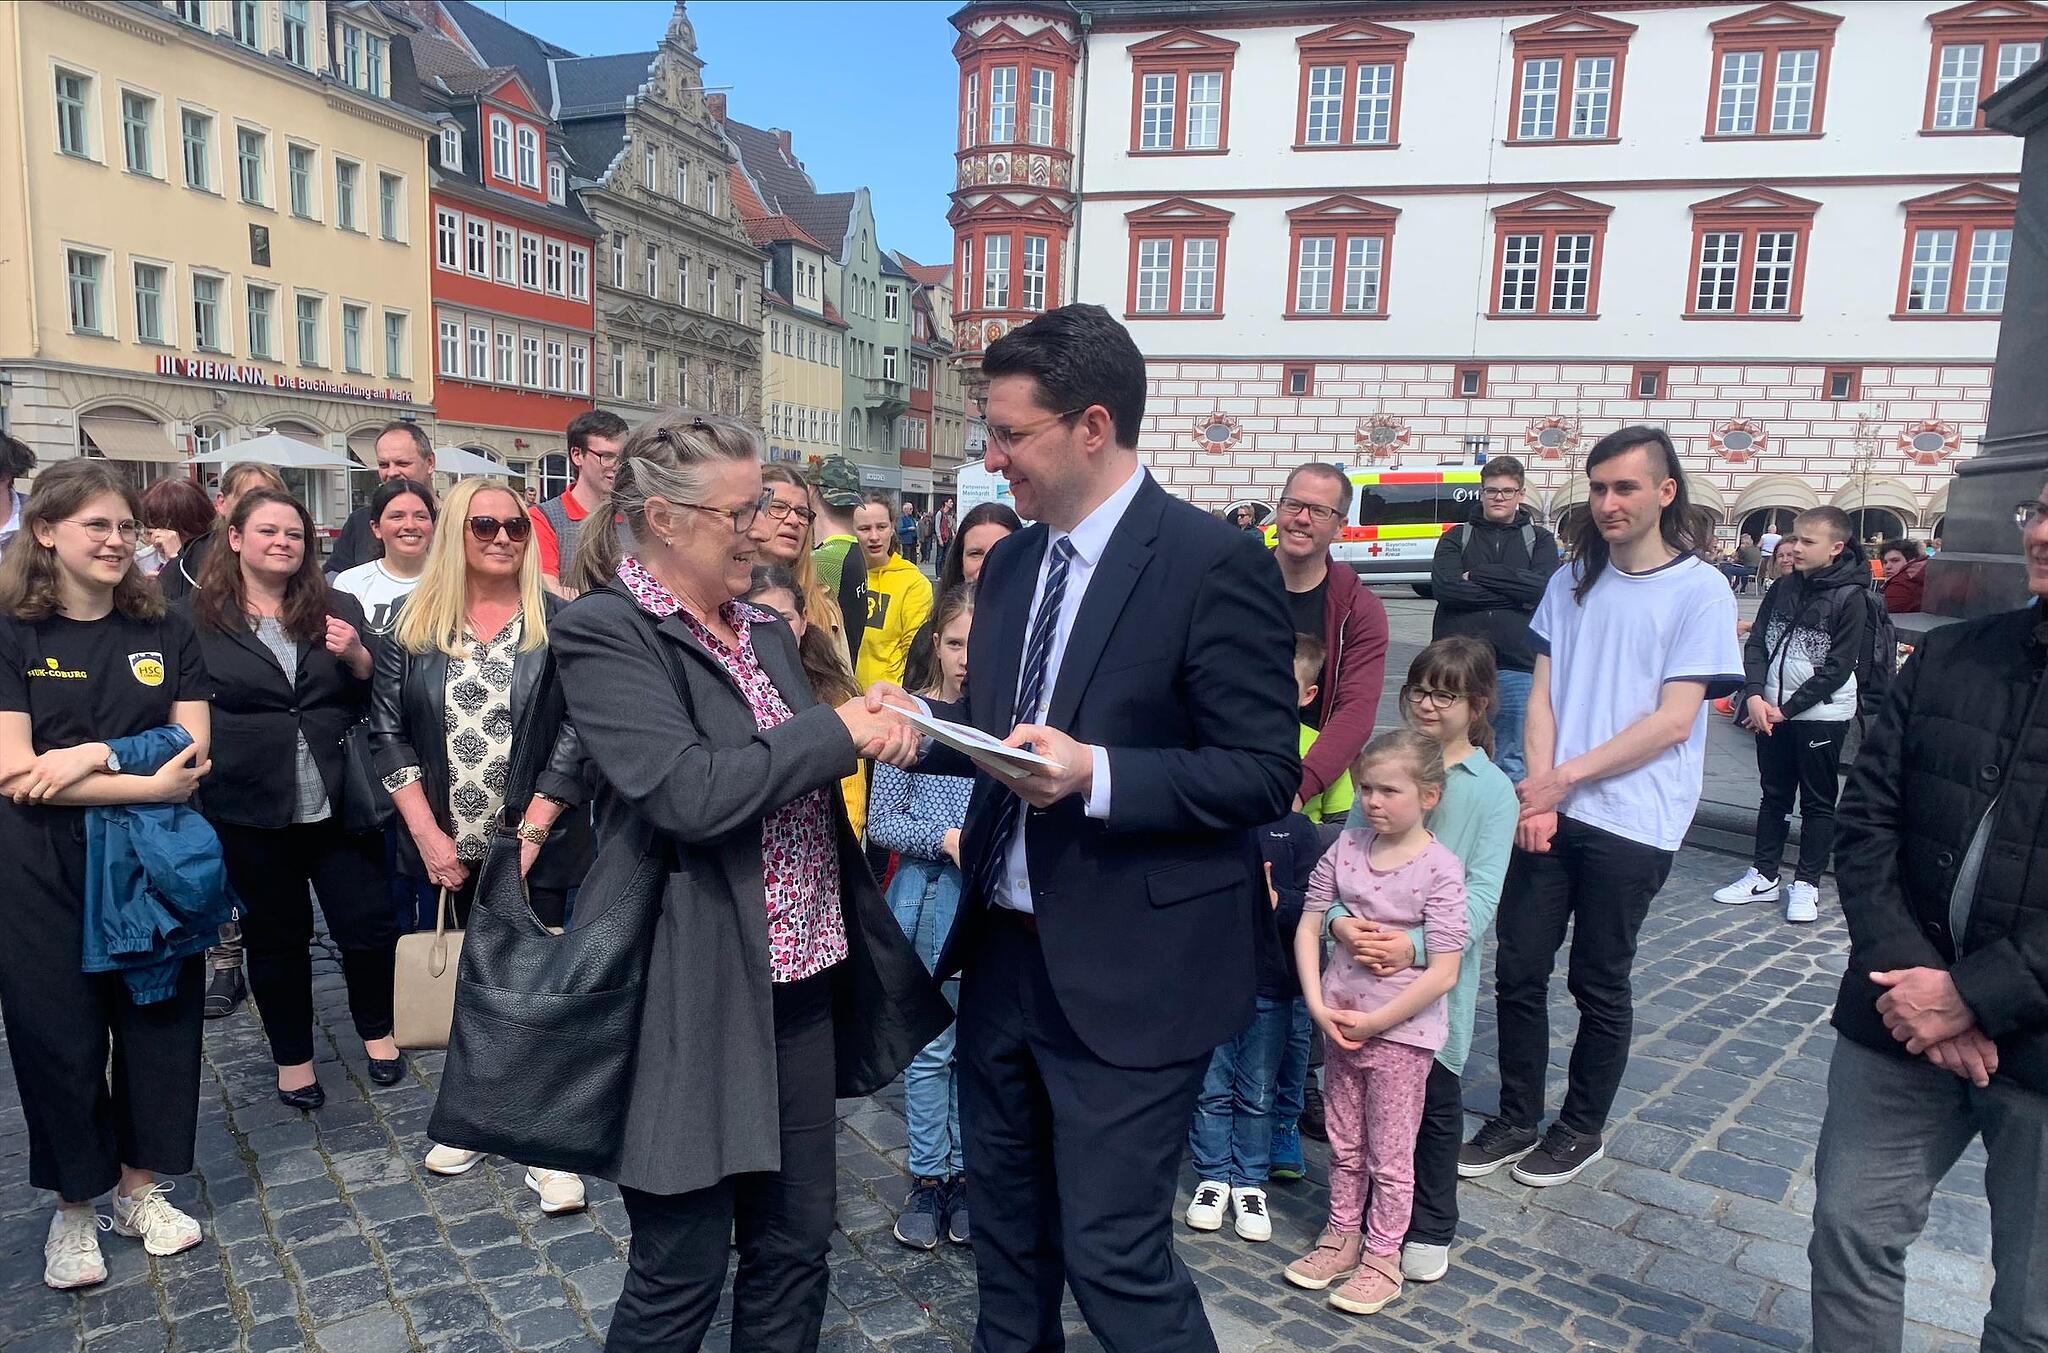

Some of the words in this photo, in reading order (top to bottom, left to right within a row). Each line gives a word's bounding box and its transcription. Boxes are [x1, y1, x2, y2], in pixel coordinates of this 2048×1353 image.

[278, 375, 296, 389] Die
[299, 378, 372, 400] Buchhandlung
[373, 389, 387, 400] am
[1468, 490, 1480, 500] 11
[27, 668, 88, 679] HUK-COBURG
[138, 666, 161, 675] HSC
